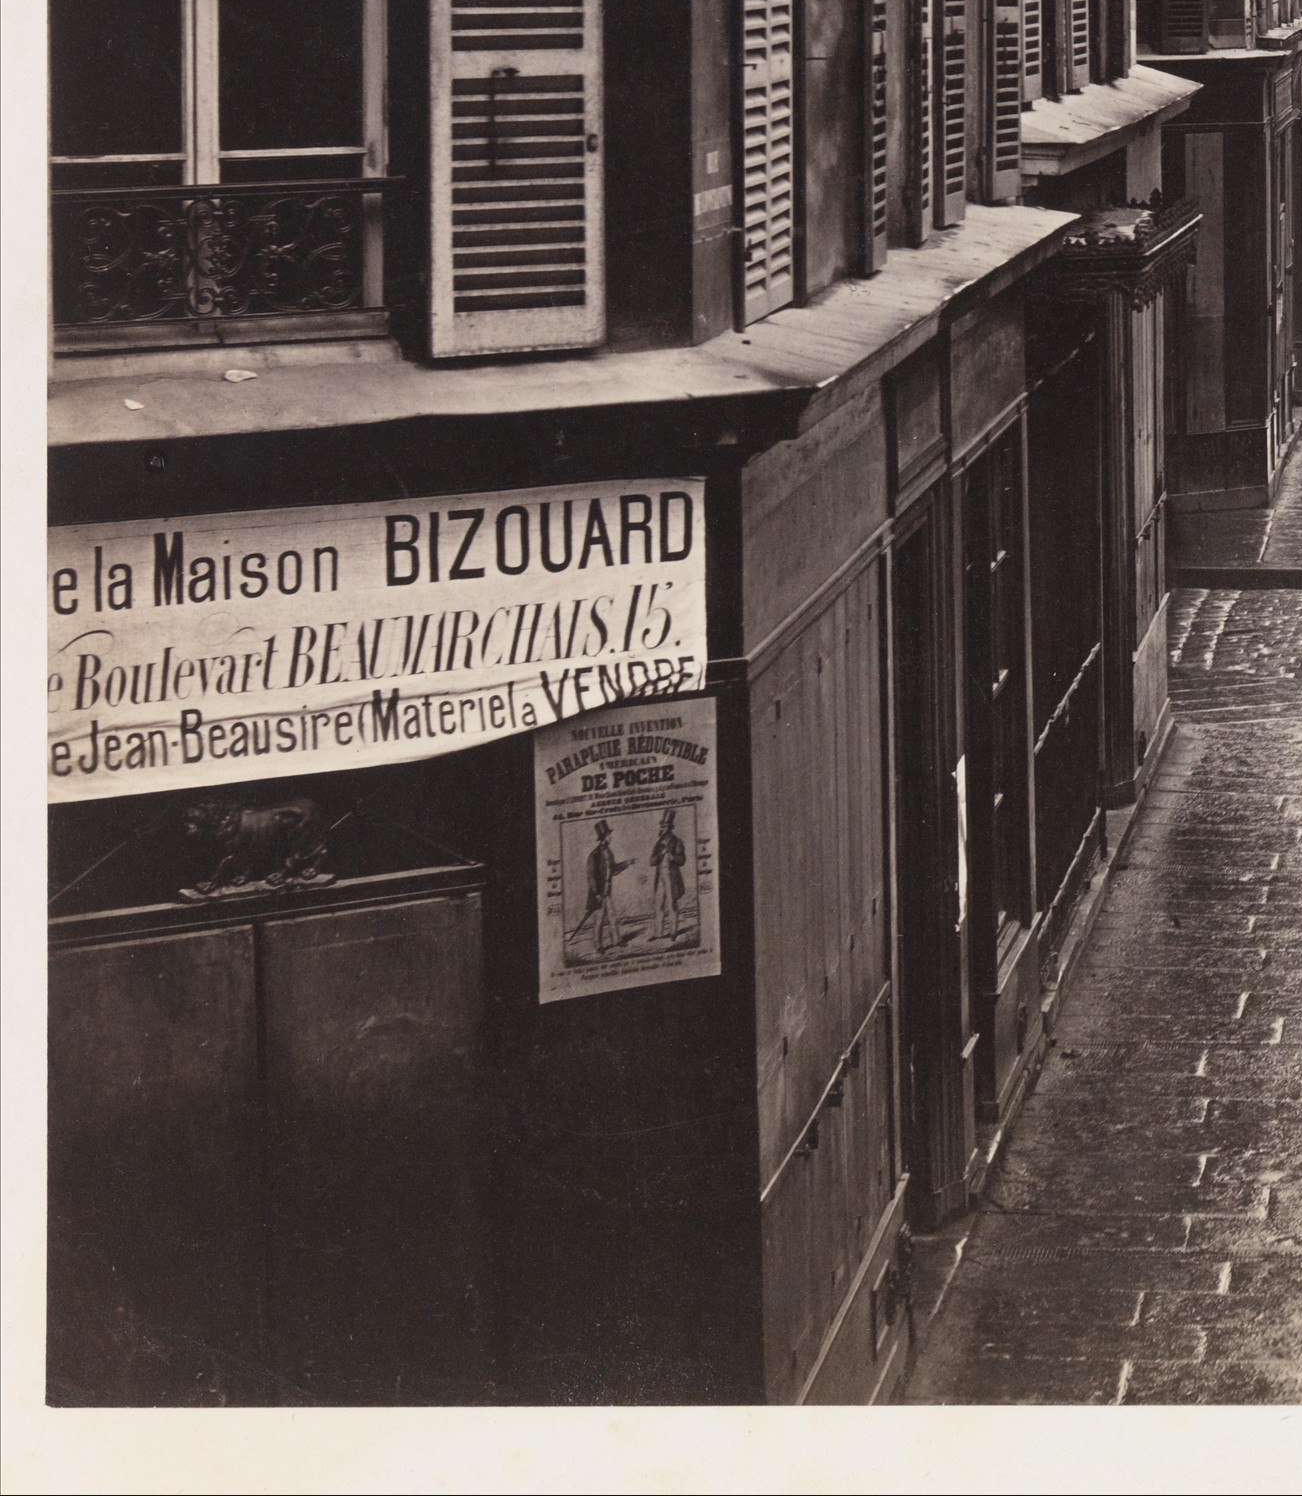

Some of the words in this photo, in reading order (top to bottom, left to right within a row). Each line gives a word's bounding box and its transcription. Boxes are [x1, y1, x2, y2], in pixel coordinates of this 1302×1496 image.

[93, 545, 133, 612] la
[153, 530, 339, 607] Maison
[385, 490, 695, 587] BIZOUARD
[71, 635, 280, 711] Boulevart
[545, 739, 622, 785] PARAPLUIE
[627, 734, 710, 766] RÉDUCTIBLE
[580, 773, 608, 793] DE
[612, 764, 675, 789] POCHE
